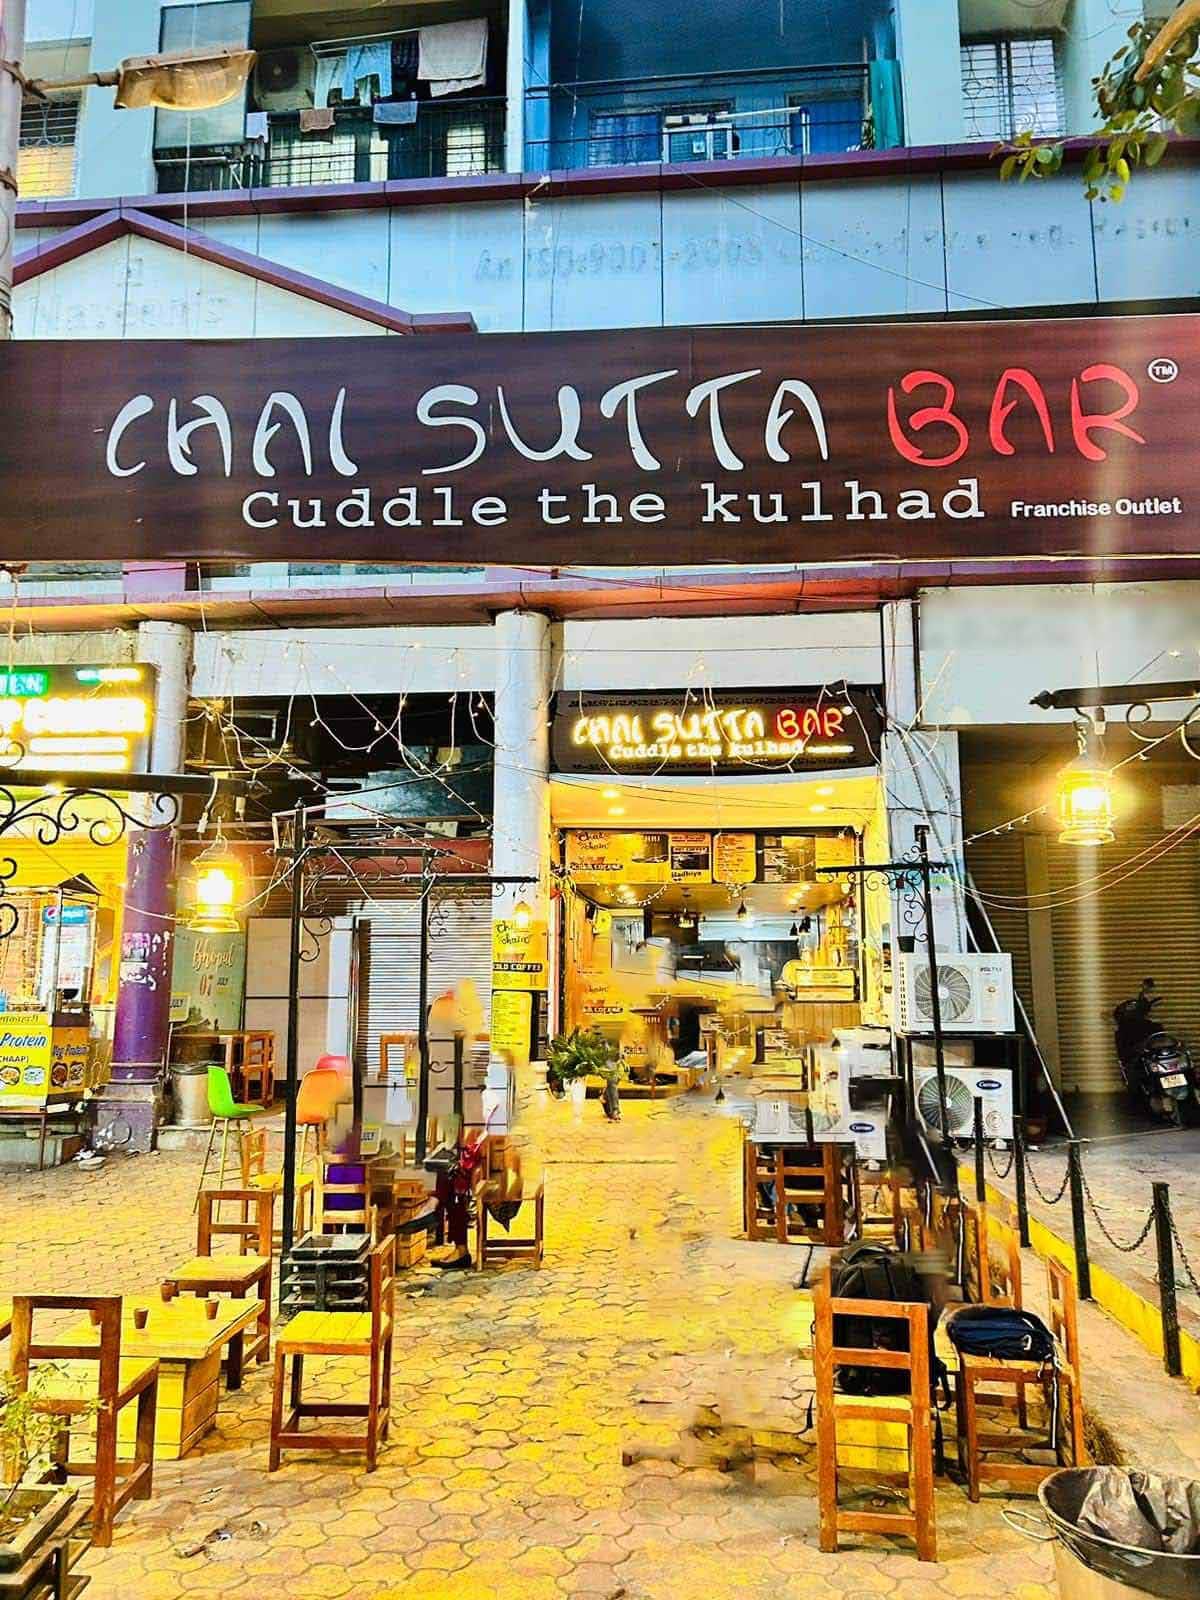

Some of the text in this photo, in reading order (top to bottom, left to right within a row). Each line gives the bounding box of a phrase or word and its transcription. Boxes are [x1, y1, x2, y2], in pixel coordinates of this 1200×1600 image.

[107, 387, 358, 477] CHAI
[416, 369, 828, 475] SUTTA
[888, 364, 1146, 468] BAR
[242, 478, 1183, 528] Cuddle the kulhad Franchise Outlet
[572, 707, 845, 744] CHAI SUTTA BAR
[1, 1032, 48, 1048] Protein
